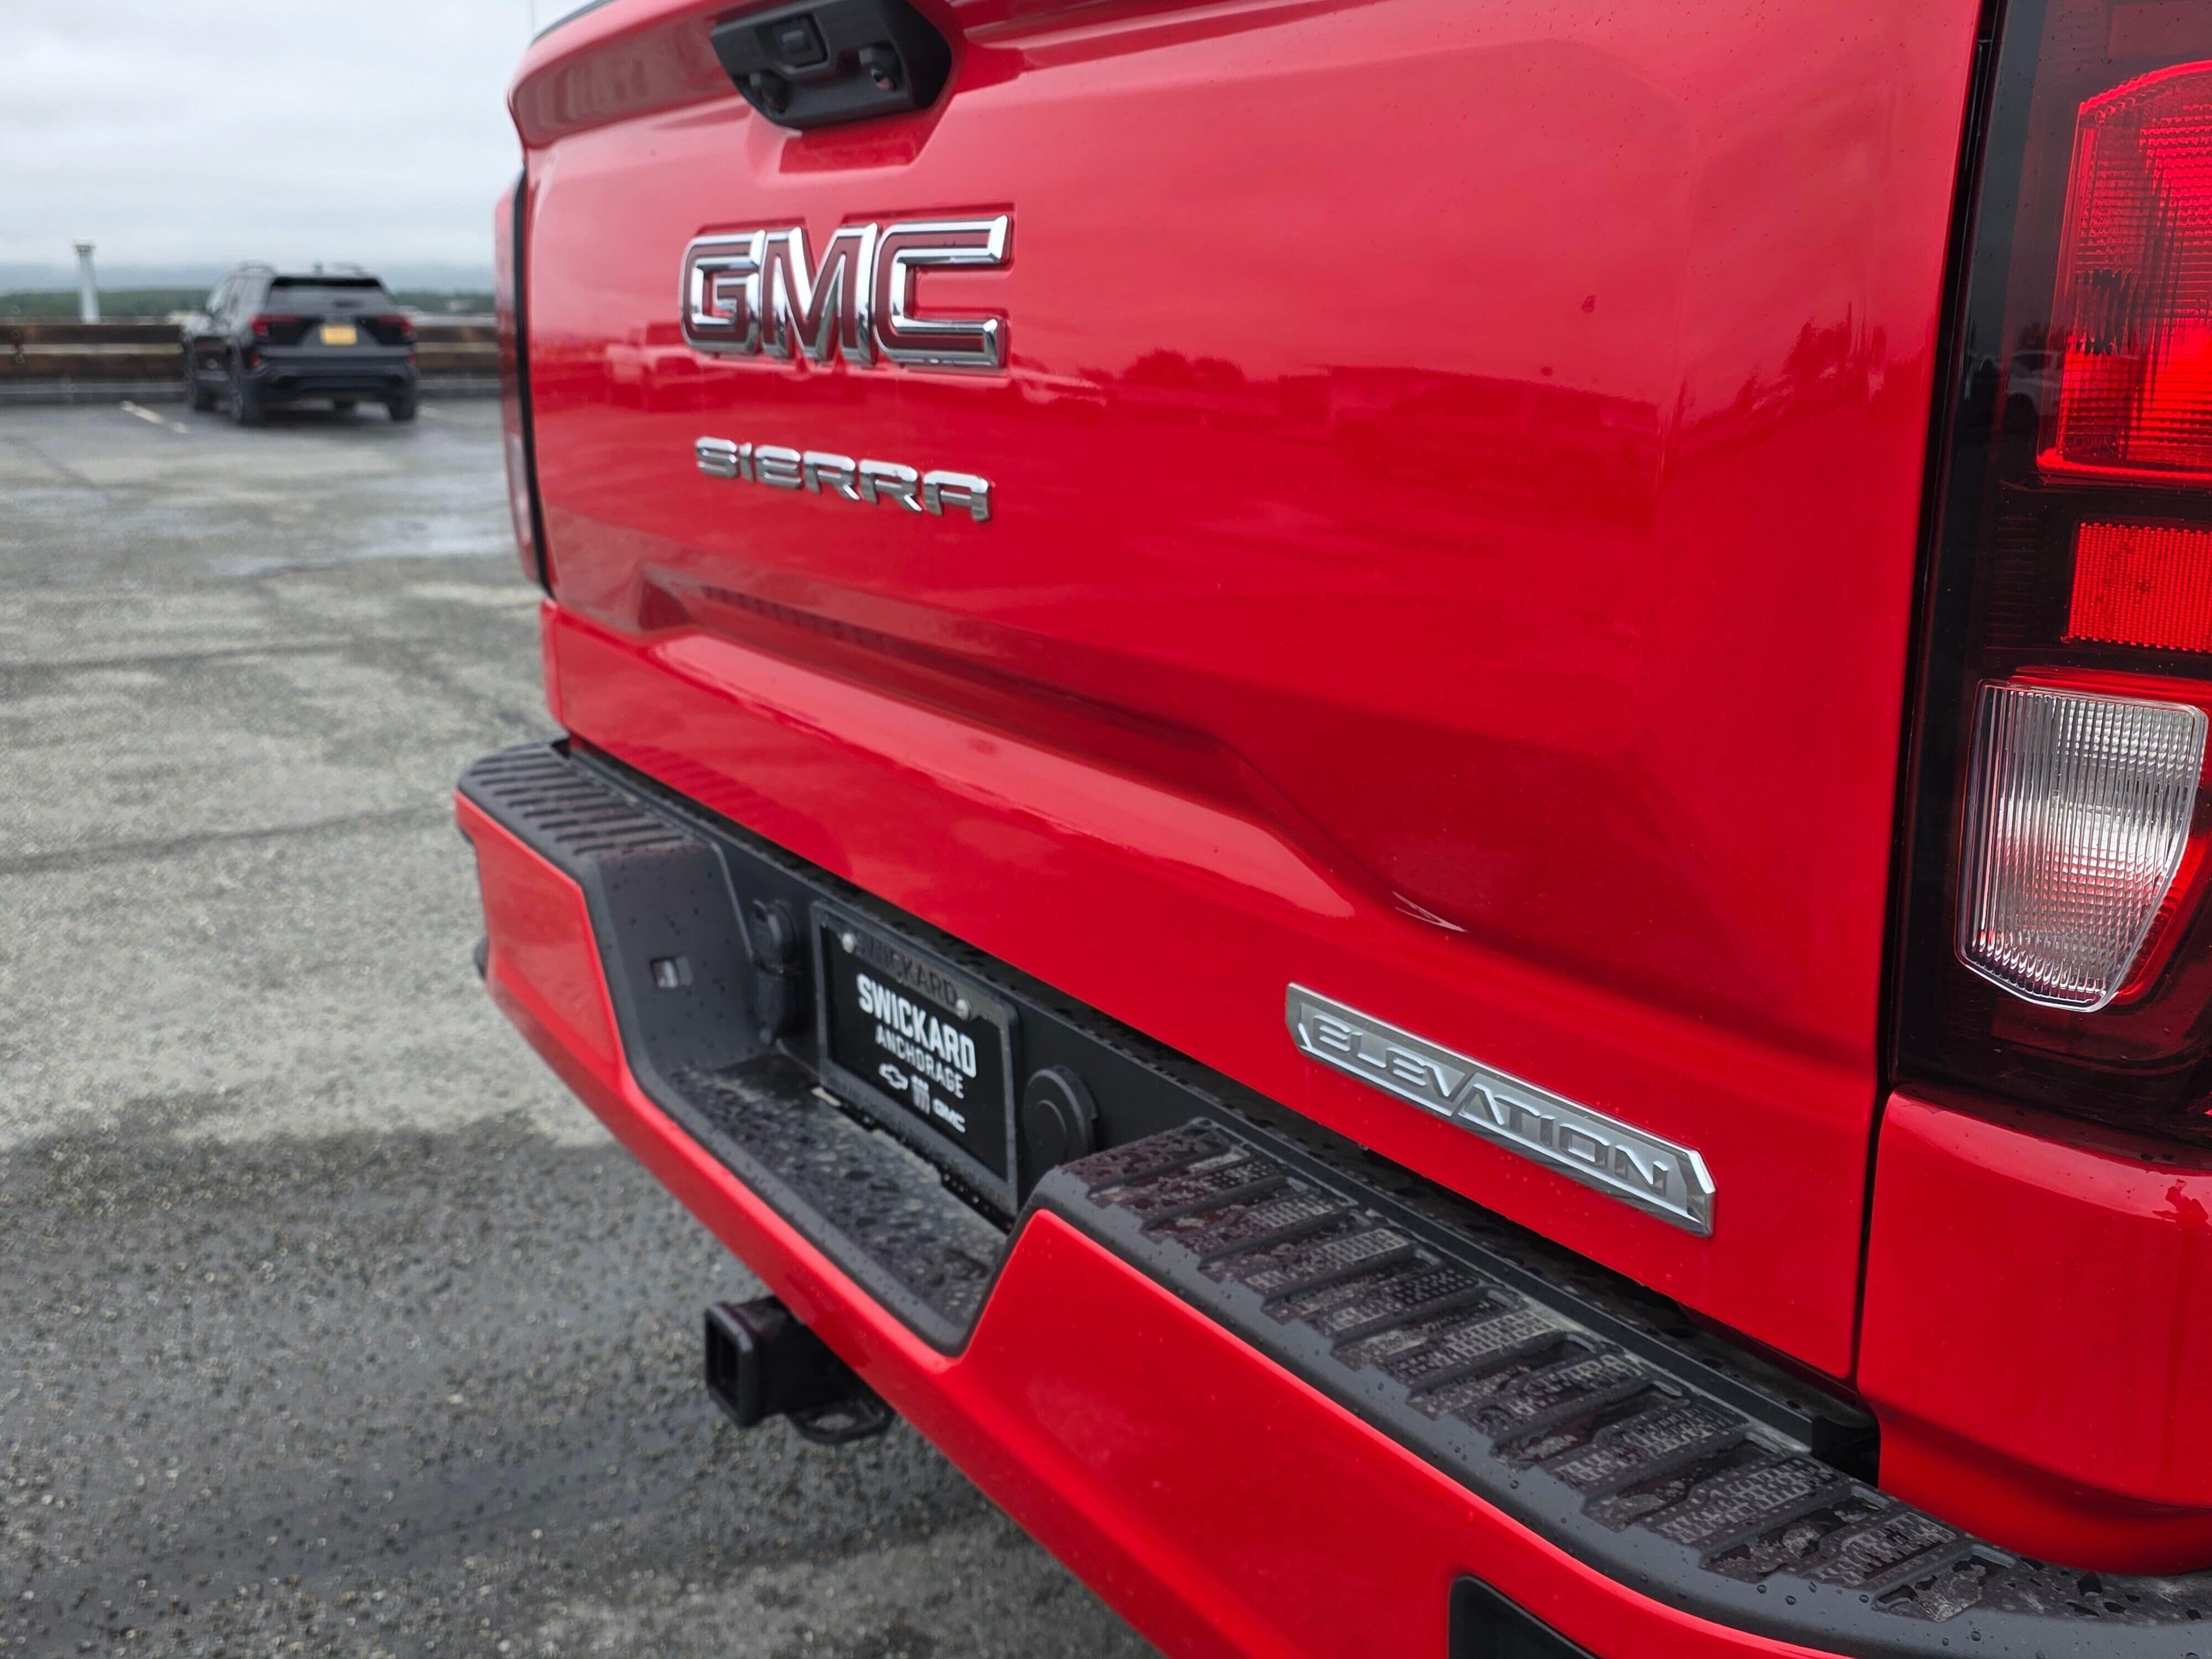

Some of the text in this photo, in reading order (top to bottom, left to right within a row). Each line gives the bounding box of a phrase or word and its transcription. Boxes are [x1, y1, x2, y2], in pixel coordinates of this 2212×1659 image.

[679, 215, 1010, 368] GMC
[695, 436, 993, 522] SIERRA
[856, 973, 977, 1078] SWICKARD
[875, 1025, 964, 1099] ANCHORAGE
[932, 1098, 966, 1133] GMC
[1312, 1014, 1669, 1197] ELEVATION
